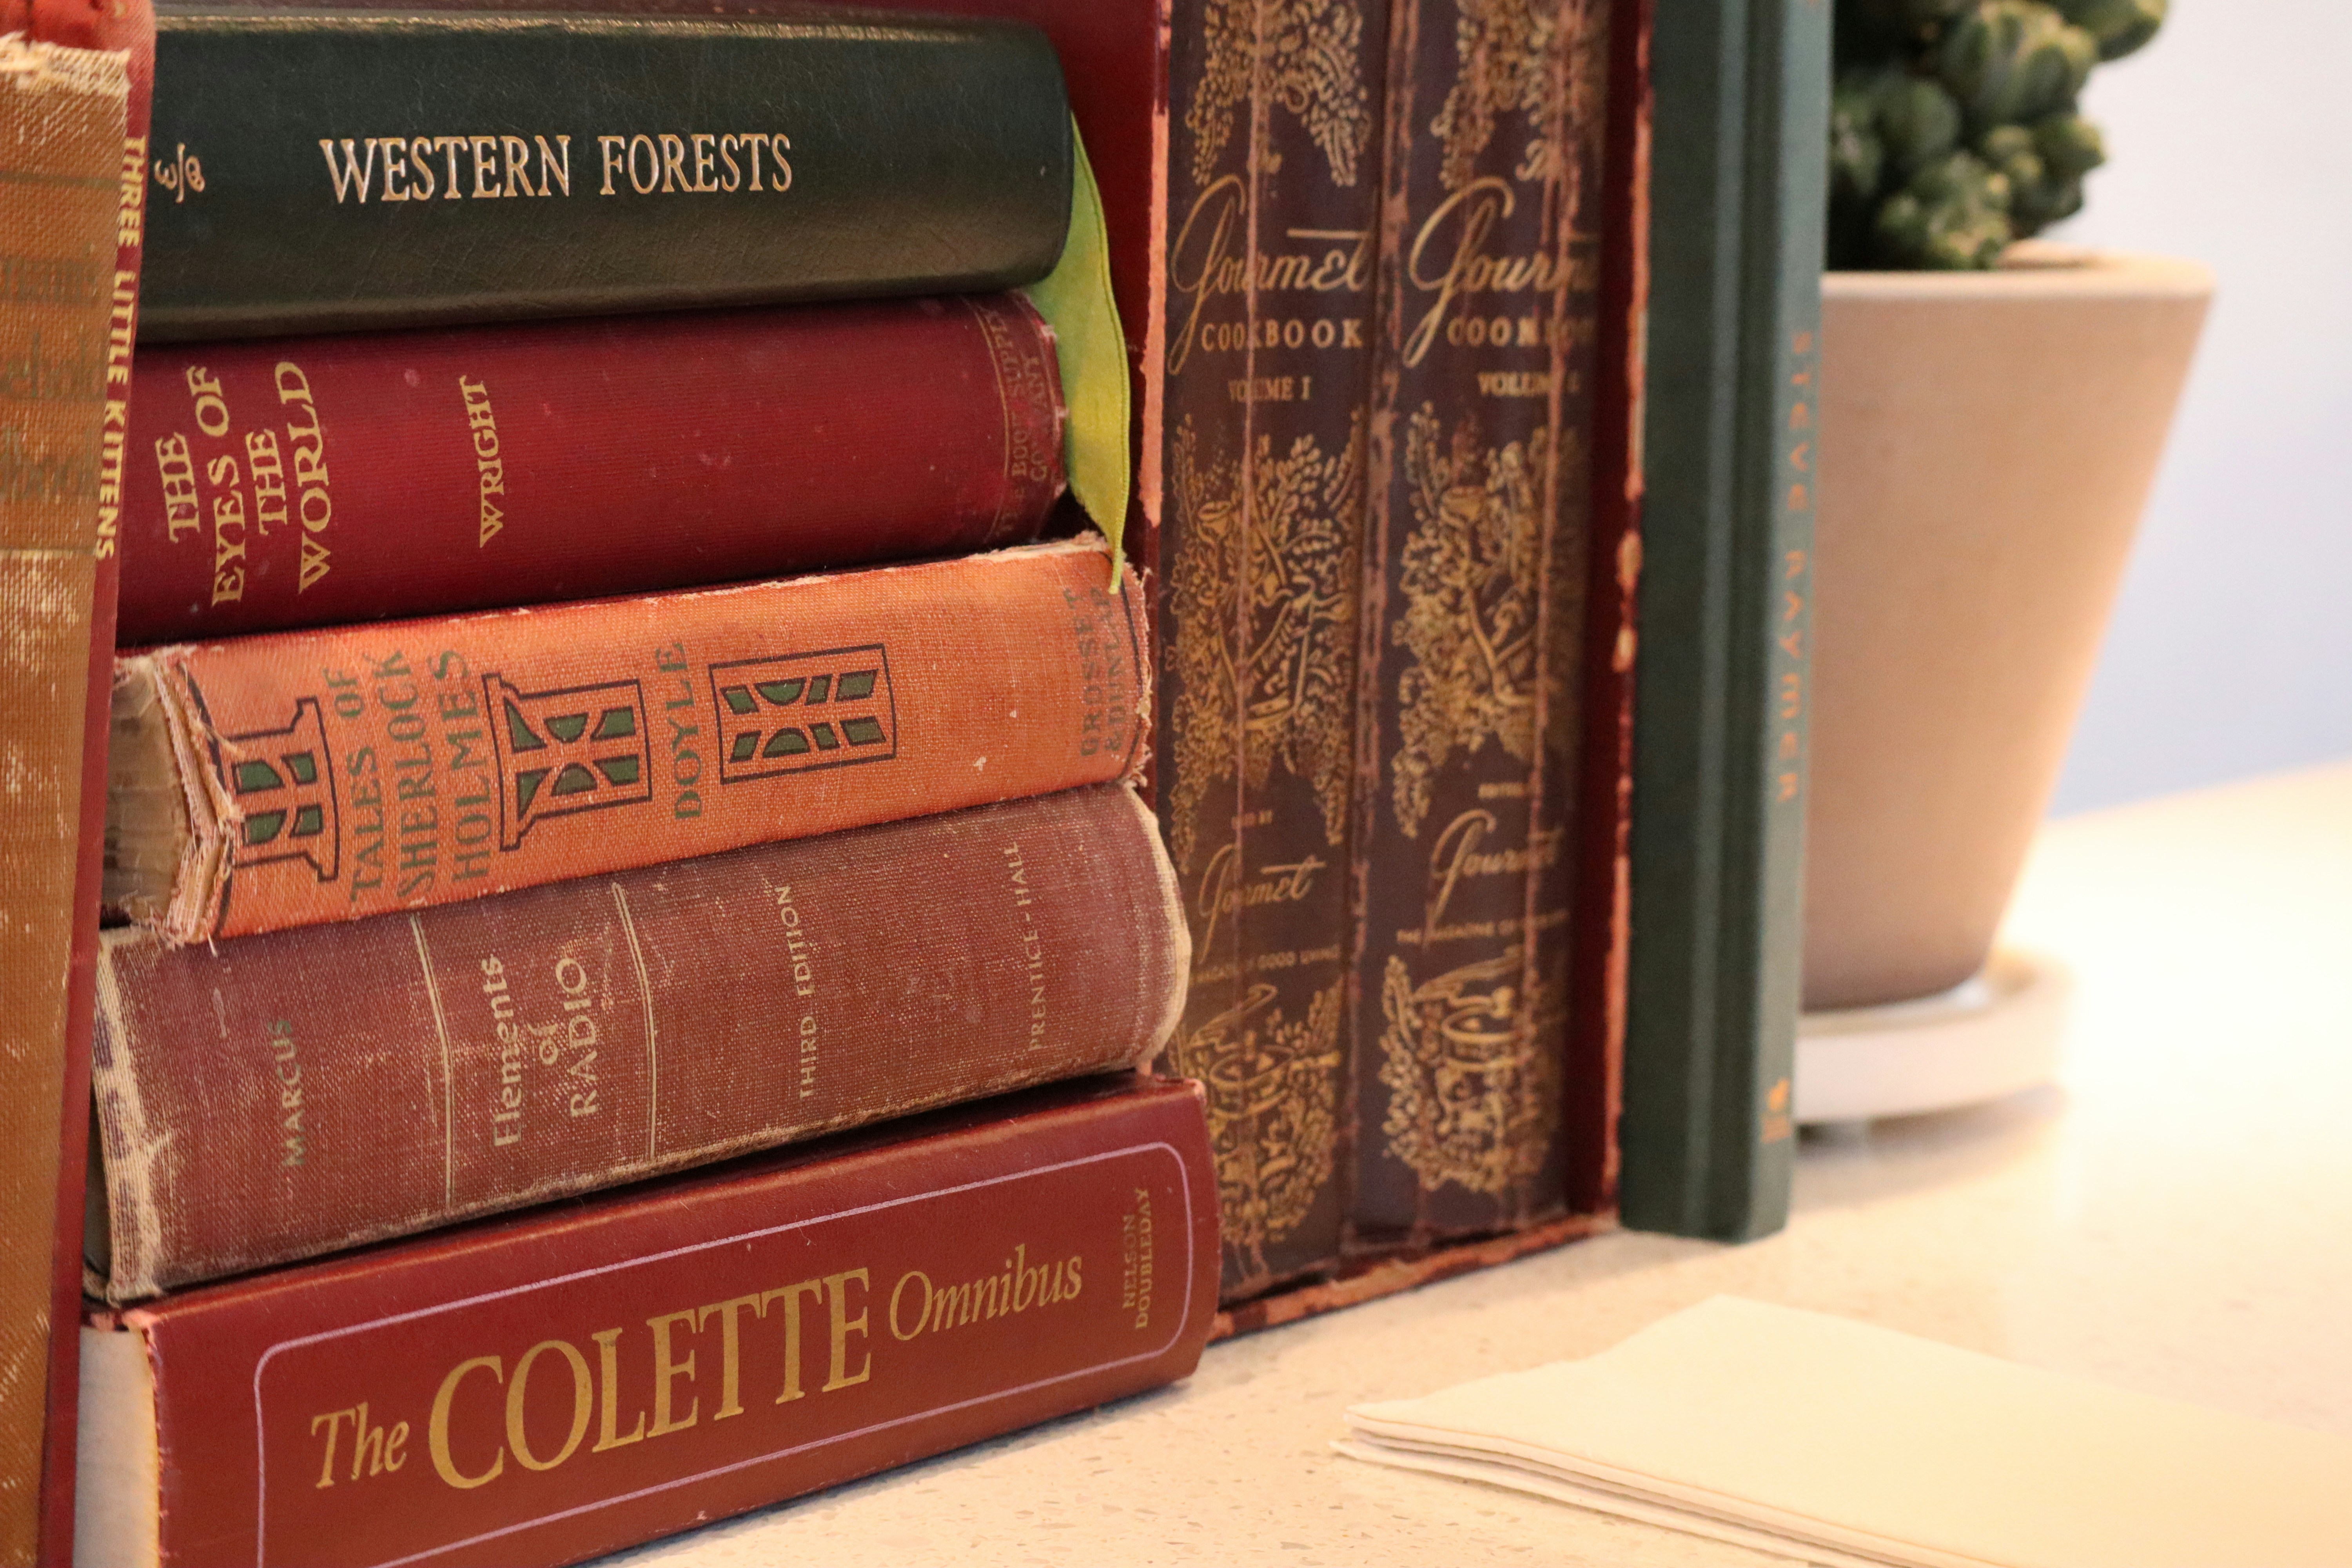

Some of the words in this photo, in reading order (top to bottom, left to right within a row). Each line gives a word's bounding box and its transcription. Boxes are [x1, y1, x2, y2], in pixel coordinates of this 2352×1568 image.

[118, 135, 147, 247] THREE
[319, 135, 571, 204] WESTERN
[597, 133, 792, 196] FORESTS
[107, 270, 136, 385] LITTLE
[186, 365, 230, 438] OF
[459, 374, 505, 548] WRIGHT
[96, 400, 128, 561] KITTENS
[155, 432, 201, 544] THE
[208, 454, 246, 607] EYES
[245, 428, 288, 536] THE
[274, 361, 332, 595] WORLD
[323, 666, 365, 720] OF
[427, 649, 492, 882] HOLMES
[655, 642, 703, 820] DOYLE
[347, 745, 385, 902] TALES
[363, 650, 439, 898] SHERLOCK
[774, 885, 816, 997] EDITION
[267, 1019, 307, 1167] MARCUS
[481, 954, 523, 1147] Elements
[527, 1019, 560, 1066] of
[555, 956, 600, 1119] RADIO
[799, 1016, 817, 1099] THIRD
[1122, 1213, 1137, 1309] NELSON
[1135, 1187, 1154, 1329] DOUBLEDAY
[311, 1402, 410, 1489] The
[428, 1267, 871, 1490] COLETTE
[889, 1243, 1083, 1341] Omnibus
